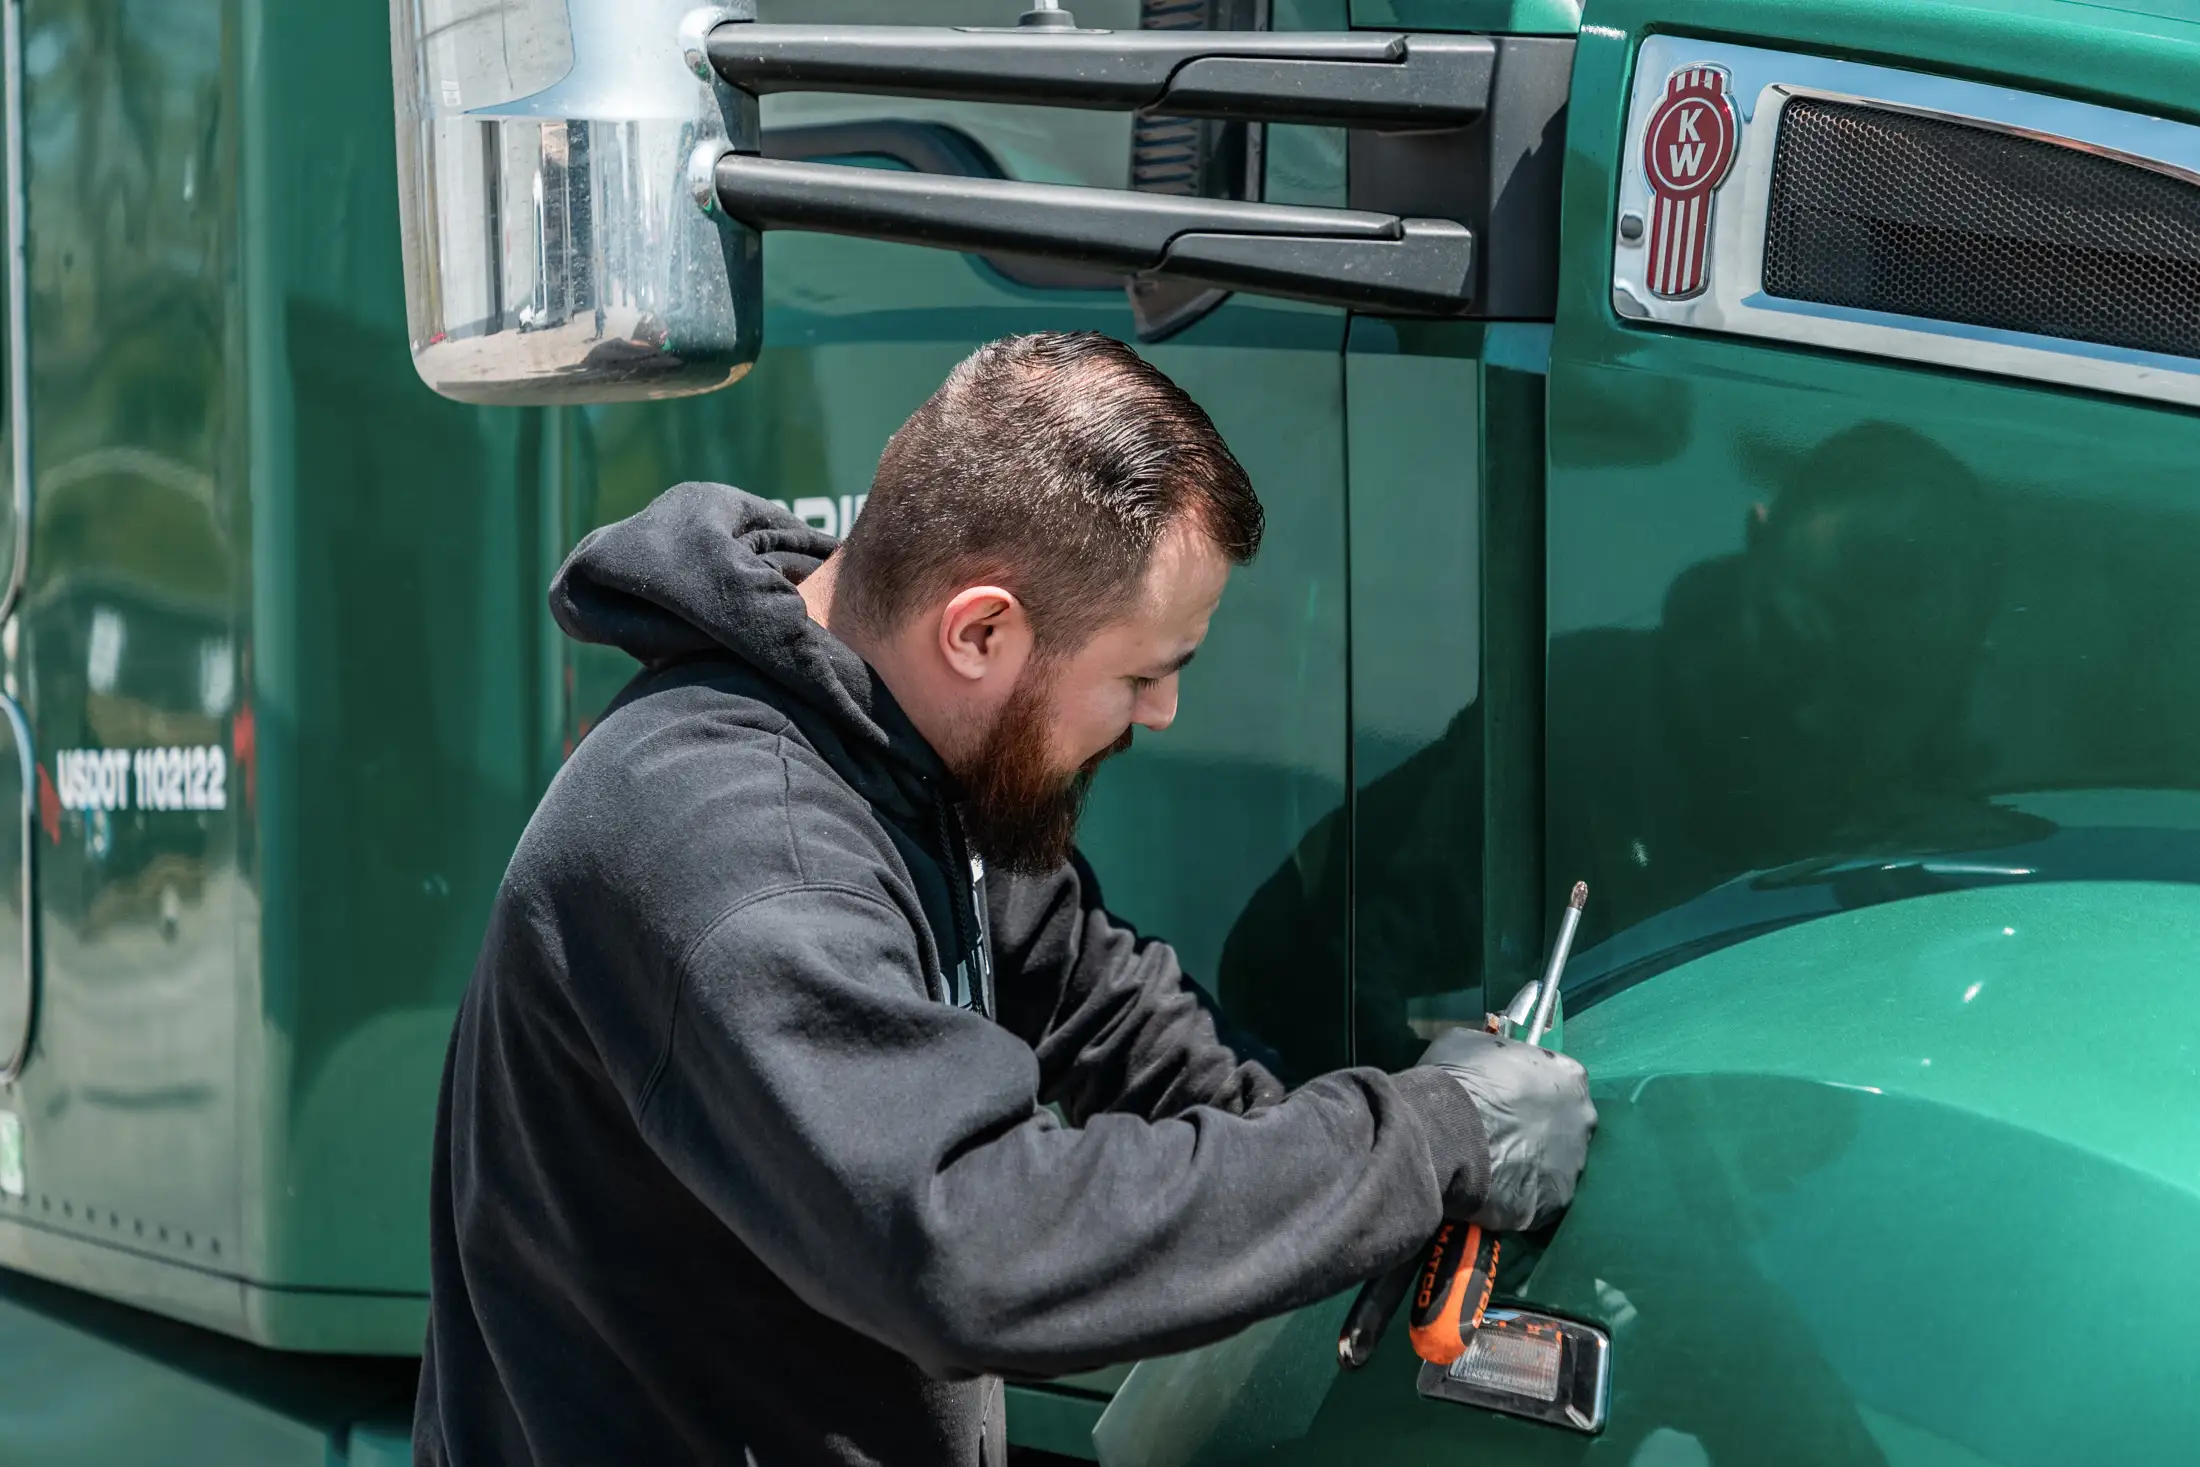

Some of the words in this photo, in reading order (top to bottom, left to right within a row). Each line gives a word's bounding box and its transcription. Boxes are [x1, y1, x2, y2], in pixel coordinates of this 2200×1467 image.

[57, 748, 130, 810] USDOT
[134, 745, 227, 810] 1102122
[1419, 1225, 1454, 1308] MATCO
